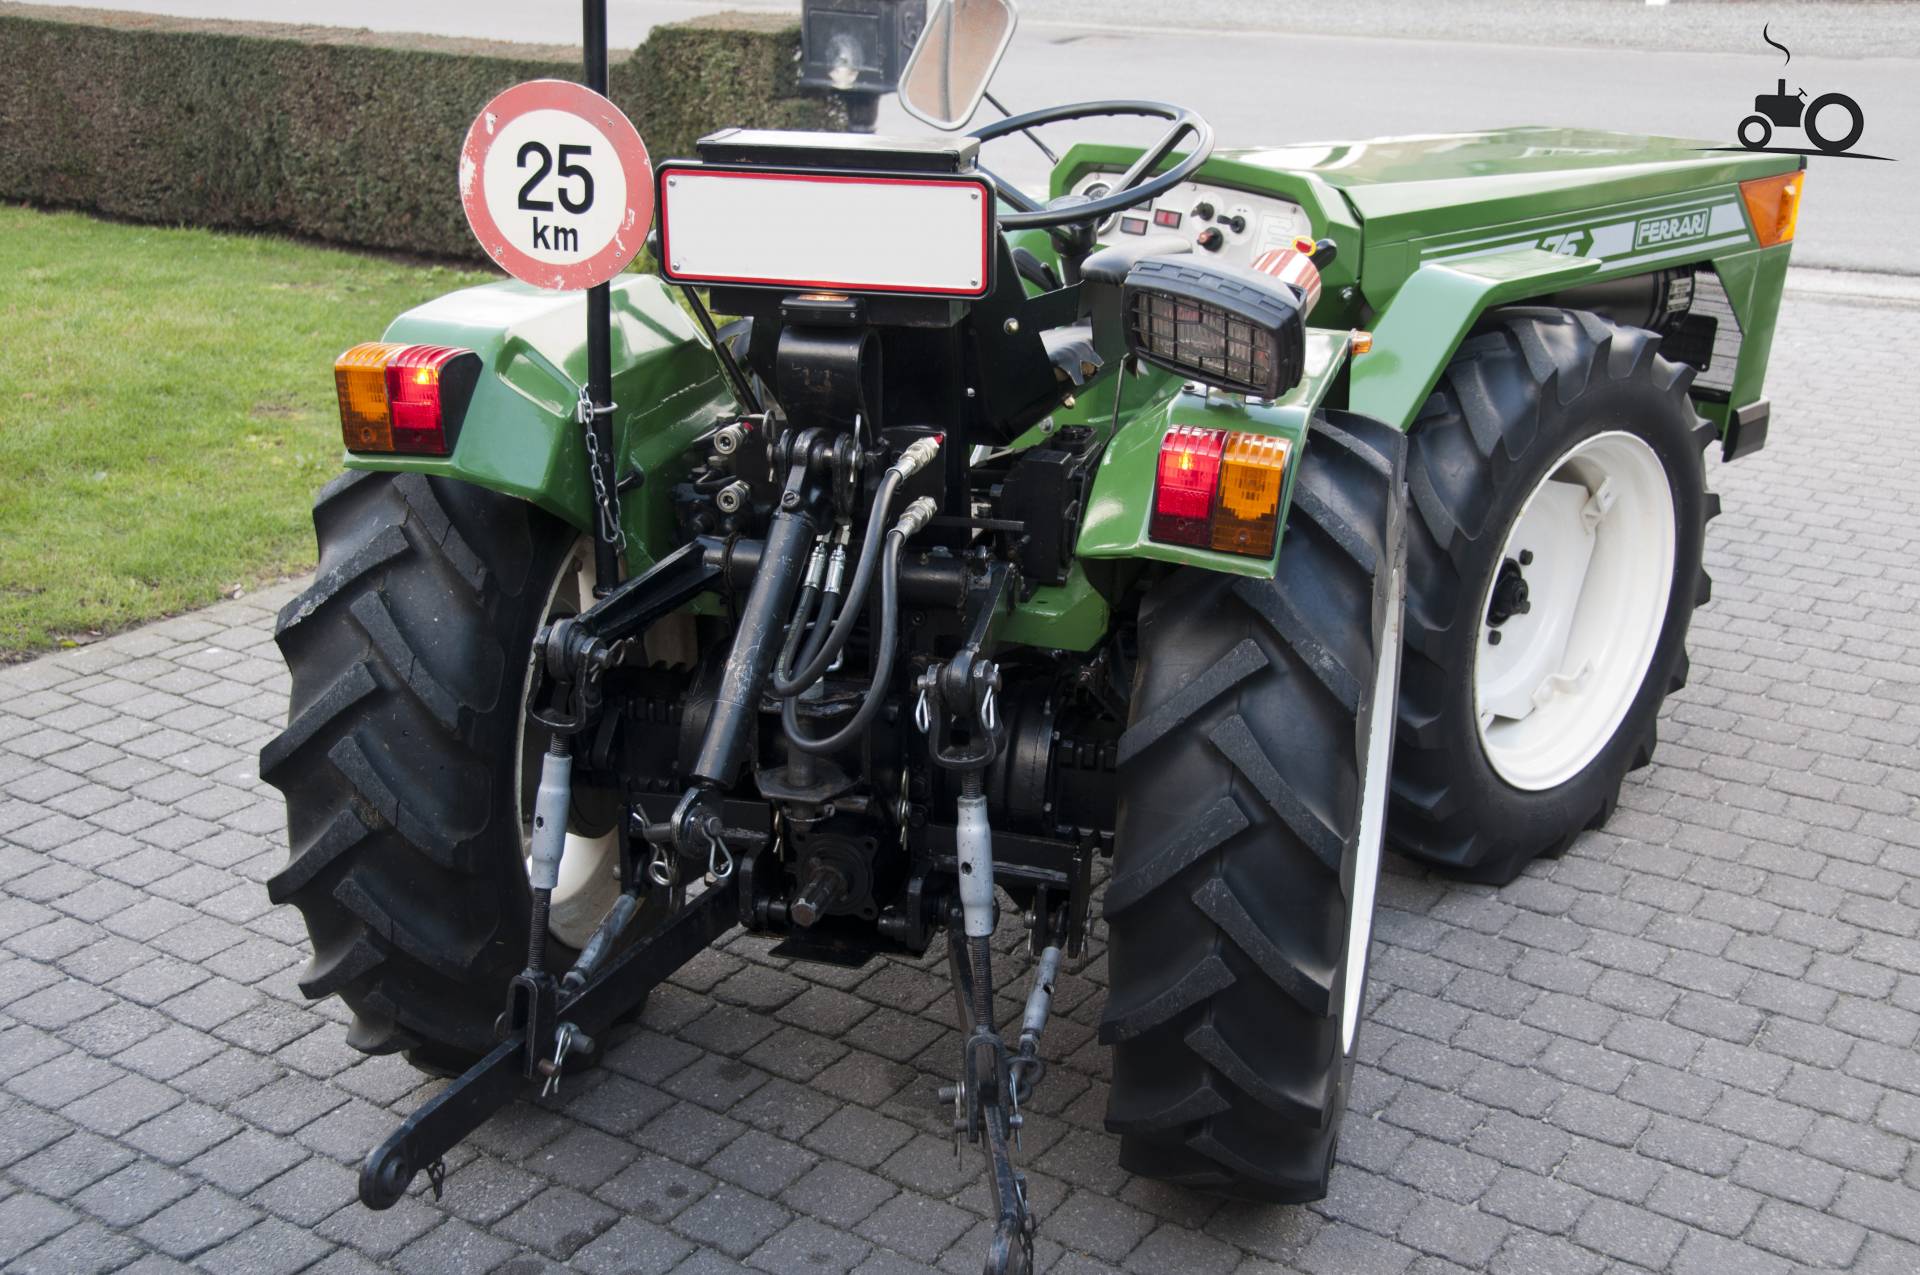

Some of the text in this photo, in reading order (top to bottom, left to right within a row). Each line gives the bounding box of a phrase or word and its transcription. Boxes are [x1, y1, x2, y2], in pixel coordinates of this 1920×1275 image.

[516, 141, 595, 215] 25
[533, 216, 579, 252] km
[1638, 212, 1707, 245] FERRARI
